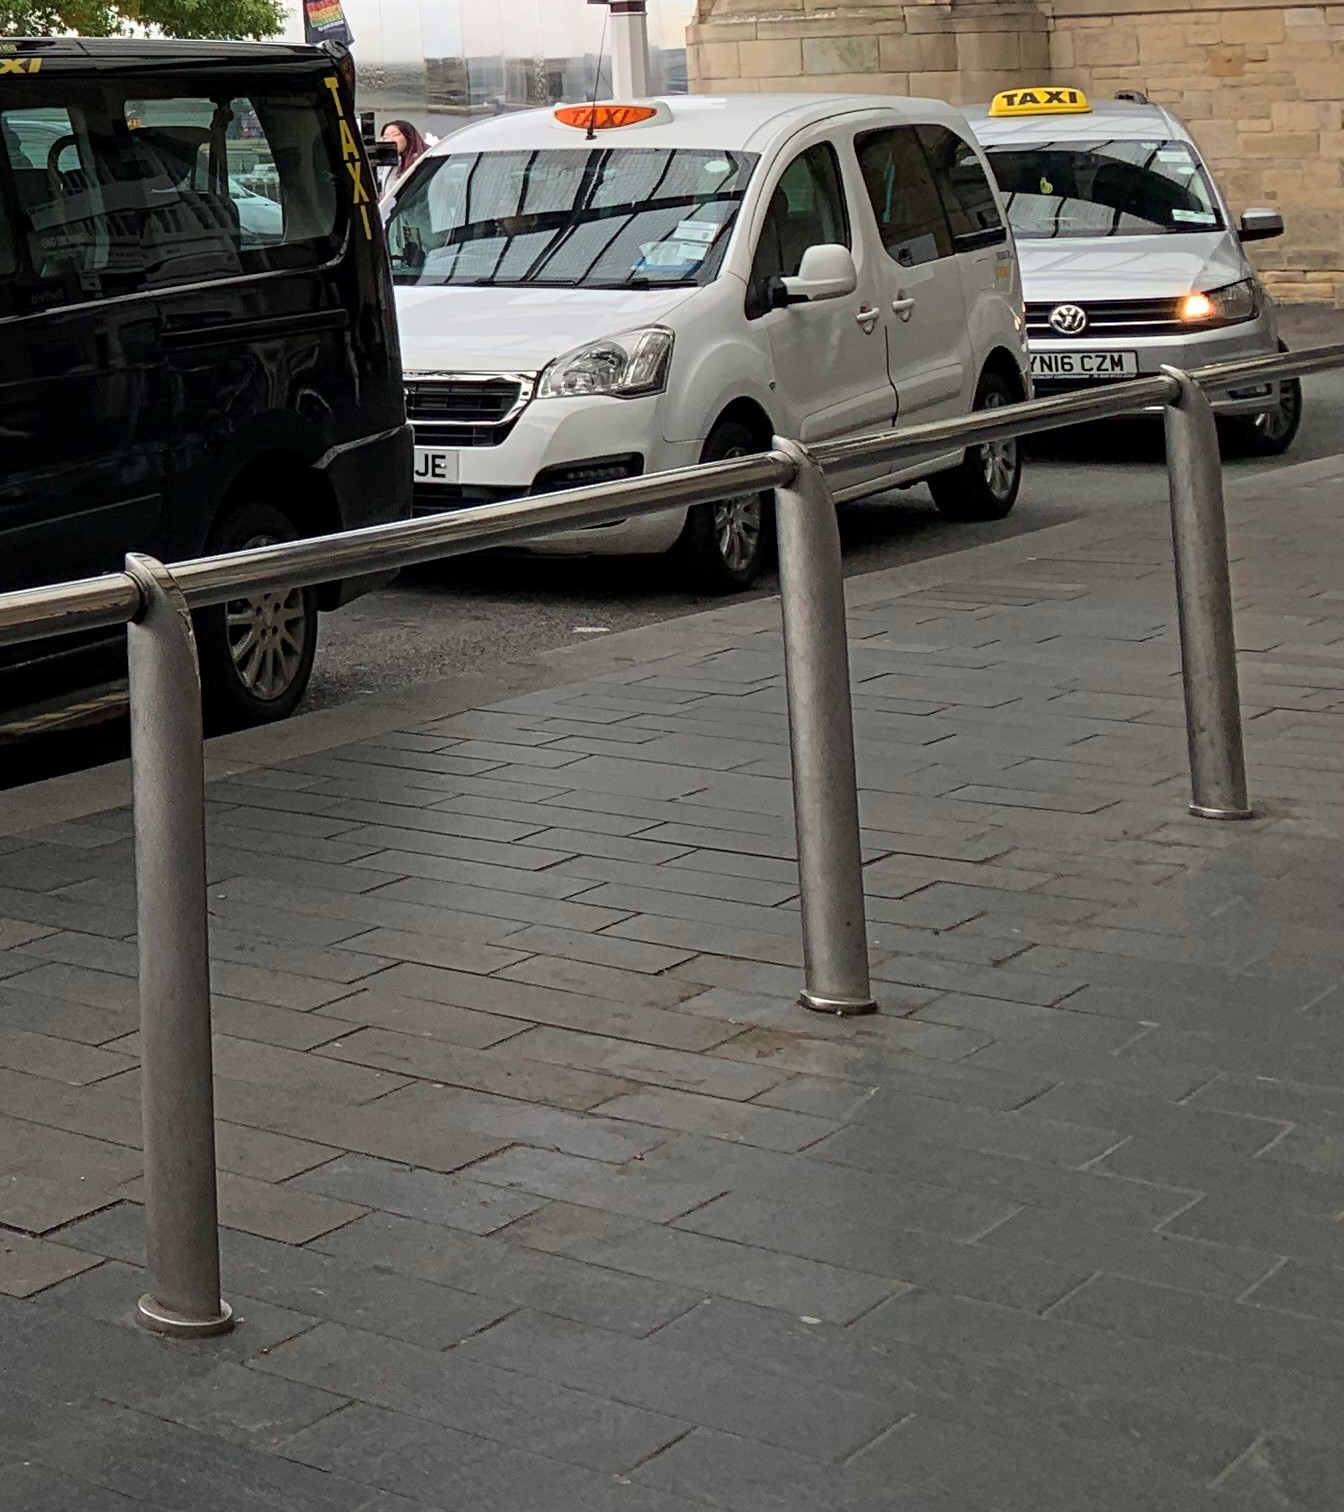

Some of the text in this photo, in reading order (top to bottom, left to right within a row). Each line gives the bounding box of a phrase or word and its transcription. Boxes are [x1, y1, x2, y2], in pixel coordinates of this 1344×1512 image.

[1002, 91, 1078, 107] TAXI
[572, 108, 630, 127] TAXI
[324, 76, 372, 240] TAXI
[1031, 354, 1124, 373] YN16 CZM
